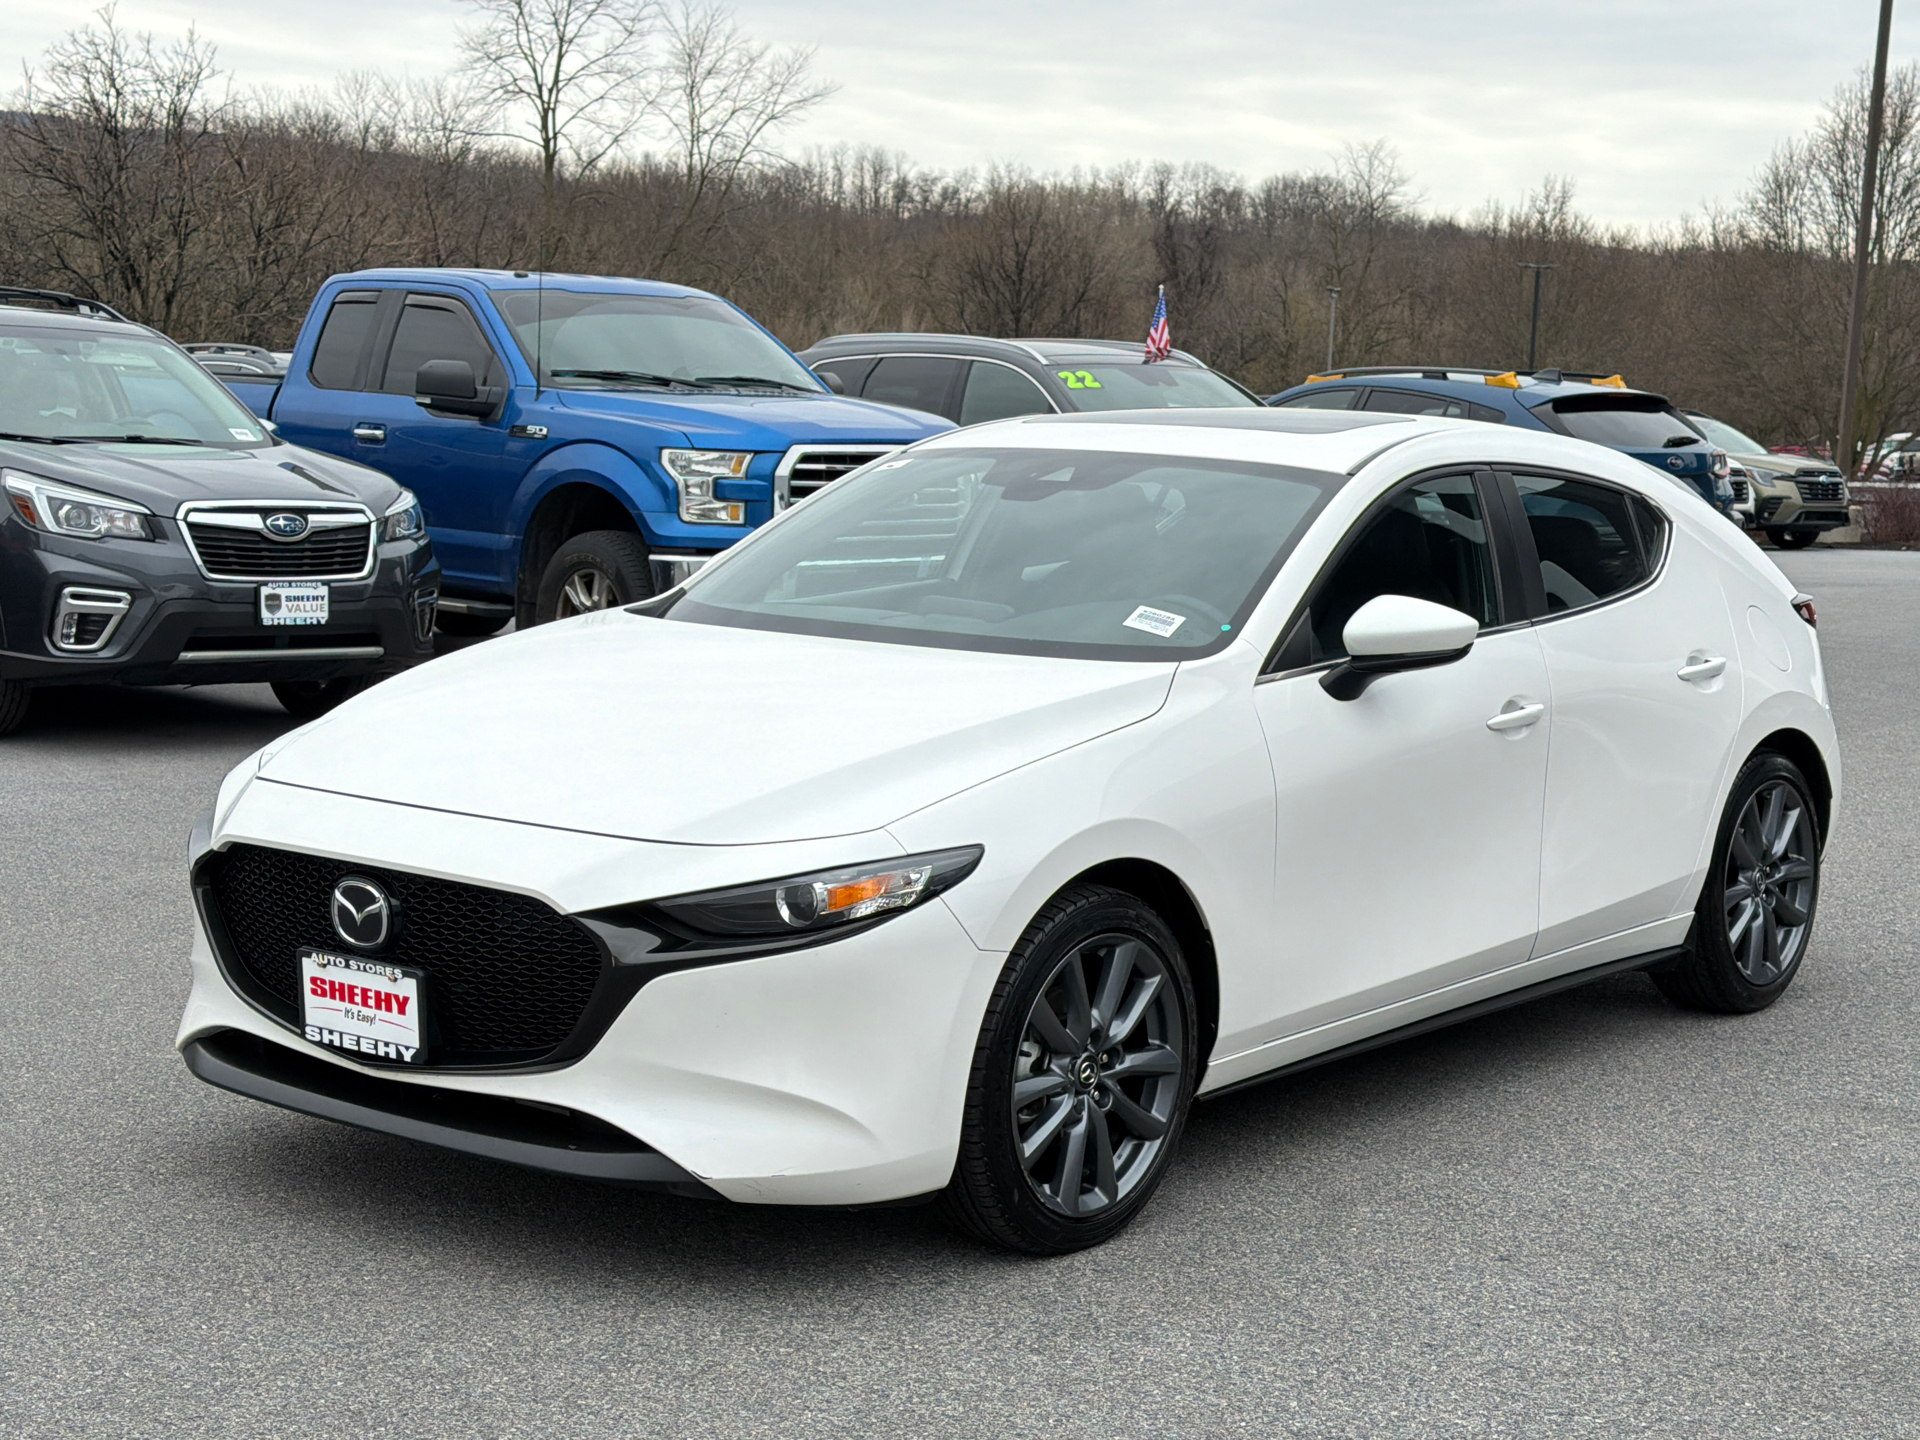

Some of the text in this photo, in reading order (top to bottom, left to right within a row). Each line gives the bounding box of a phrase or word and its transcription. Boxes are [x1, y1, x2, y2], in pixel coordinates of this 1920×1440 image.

[1058, 371, 1101, 388] 22
[285, 603, 326, 613] VALUE
[262, 617, 328, 626] SHEEHY
[310, 953, 403, 979] AUTO STORES
[309, 976, 411, 1017] SHEEHY
[344, 1007, 377, 1027] It's Easy!
[305, 1025, 417, 1062] SHEEHY
